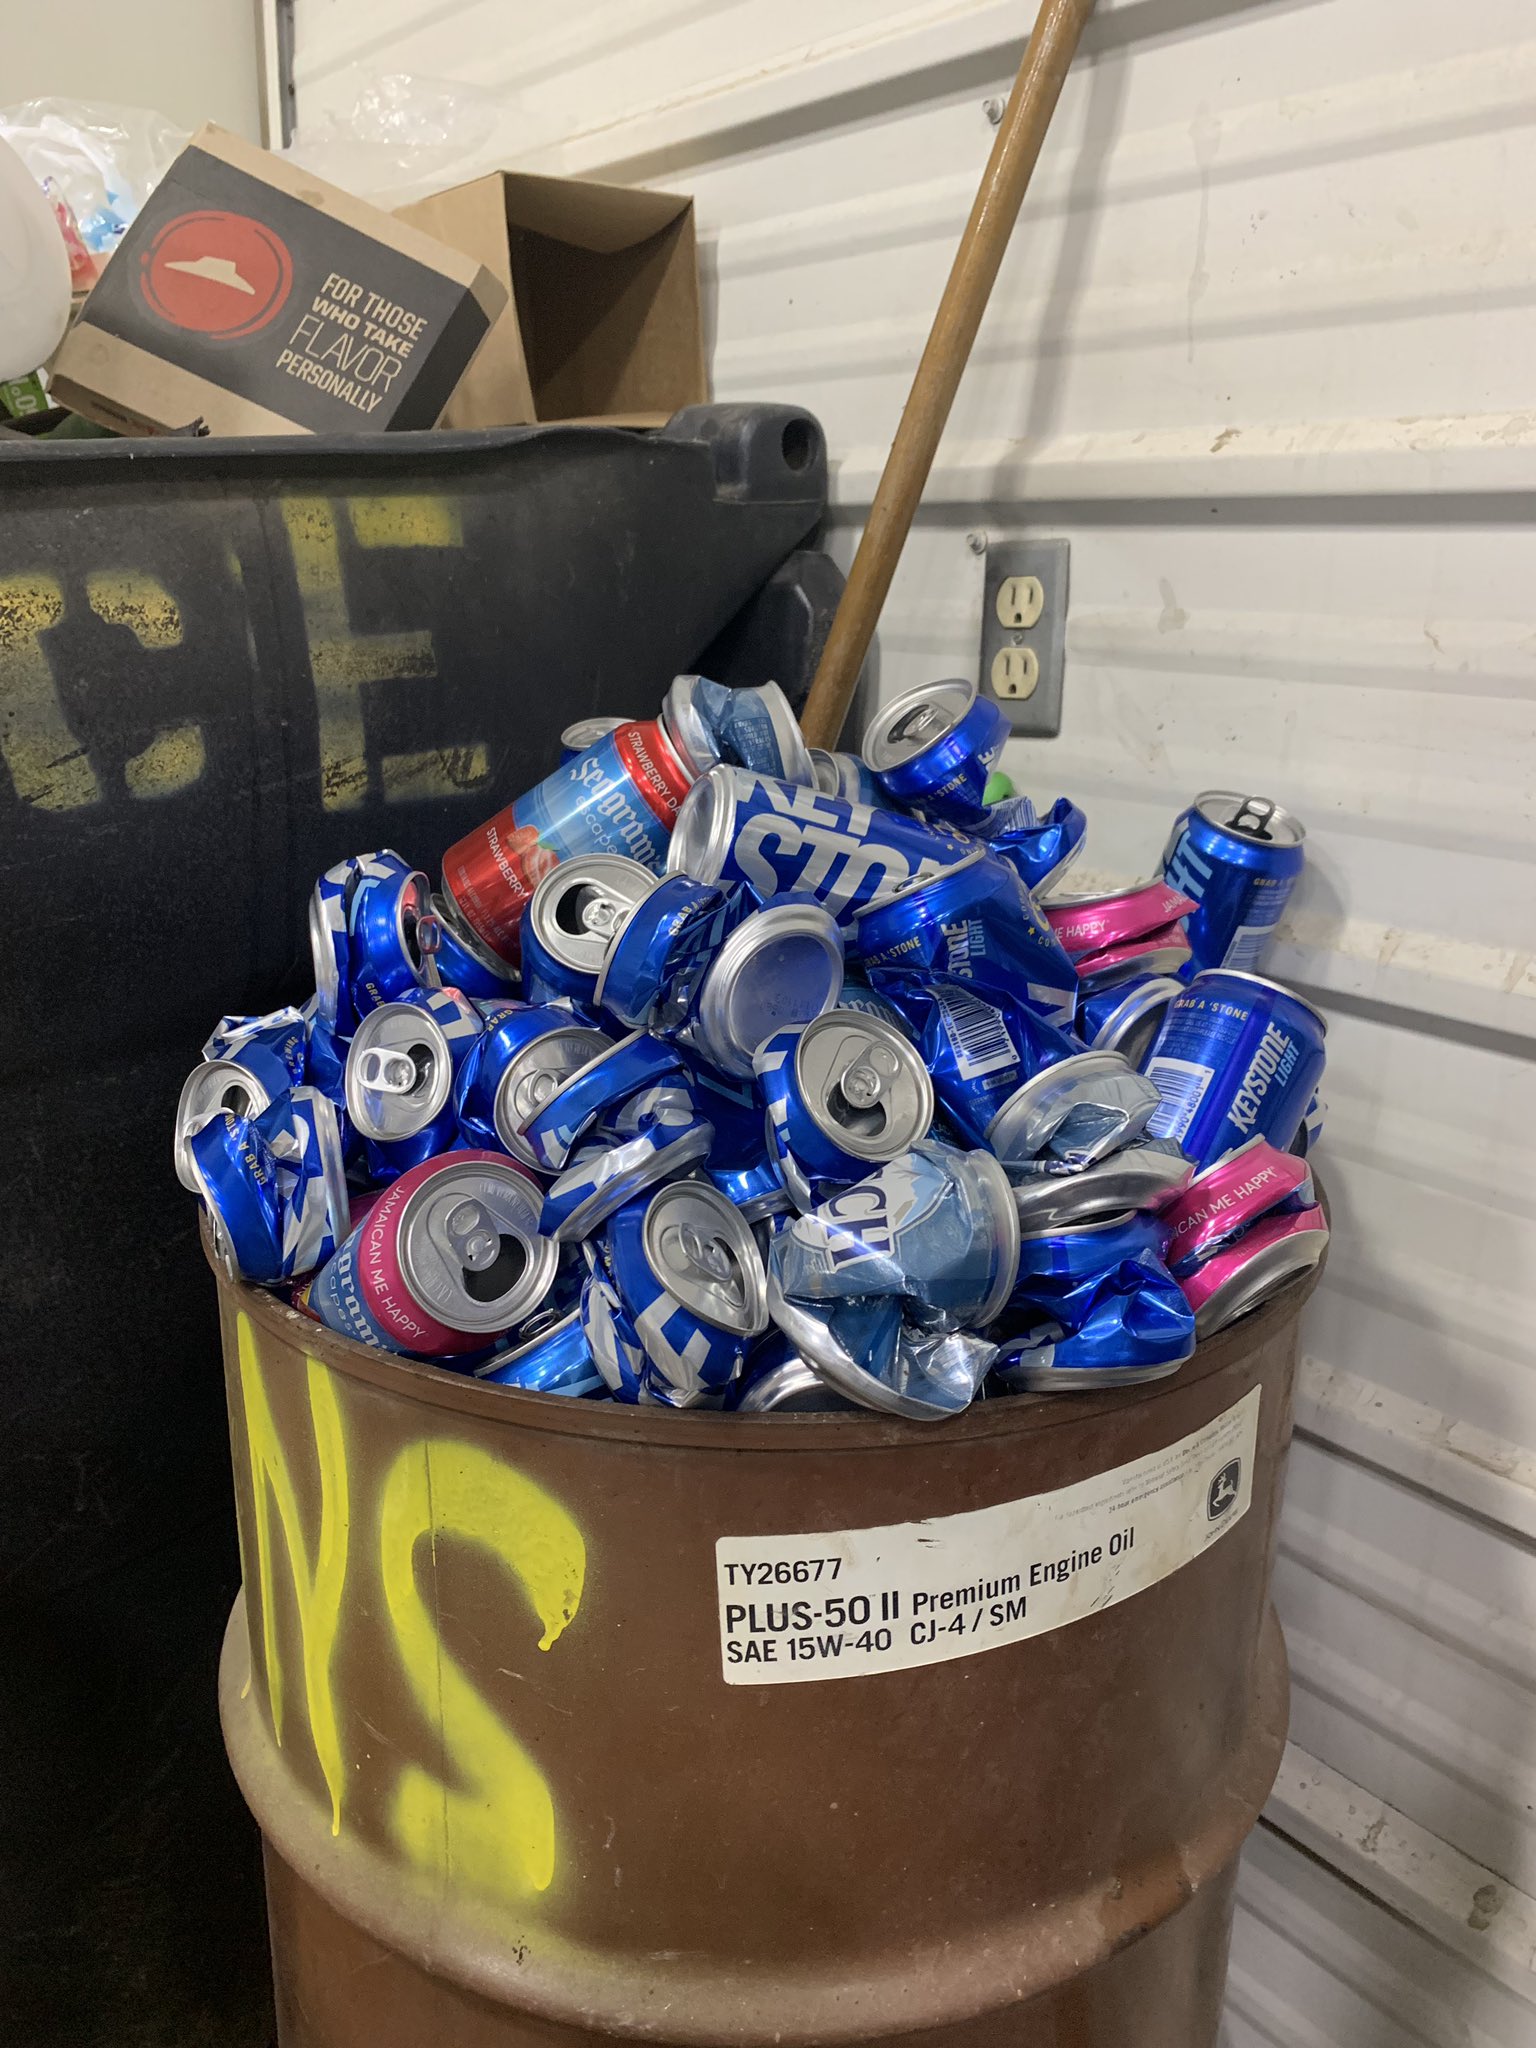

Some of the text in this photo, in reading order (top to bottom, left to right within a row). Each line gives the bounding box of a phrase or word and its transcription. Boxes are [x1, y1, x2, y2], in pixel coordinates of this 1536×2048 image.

[311, 296, 414, 358] WHO TAKE
[320, 272, 428, 341] FOR THOSE
[275, 348, 383, 413] PERSONALLY
[289, 313, 403, 393] FLAVOR
[628, 731, 671, 798] STRAWBERRY
[576, 795, 618, 855] escape
[485, 826, 527, 898] STRAWBERRY
[734, 813, 956, 922] STO
[967, 919, 987, 957] LIGHT
[1066, 920, 1106, 938] HAPPY
[1173, 998, 1195, 1009] GRAB
[1198, 999, 1206, 1010] A
[1226, 1021, 1290, 1135] KEYSTONE
[1274, 1040, 1300, 1088] LIGHT
[238, 1140, 250, 1151] A
[245, 1152, 268, 1186] GRAB
[1208, 1193, 1236, 1215] ME
[1233, 1166, 1277, 1200] HAPPY
[369, 1185, 426, 1339] JAMAICAN ME HAPPY
[724, 1557, 843, 1586] TY26677
[726, 1526, 1135, 1634] PLUS-50 II Premium Engine Oil
[727, 1639, 778, 1664] SAE
[787, 1628, 892, 1661] 15W-40
[910, 1613, 967, 1646] CJ-4
[989, 1596, 1027, 1627] SM
